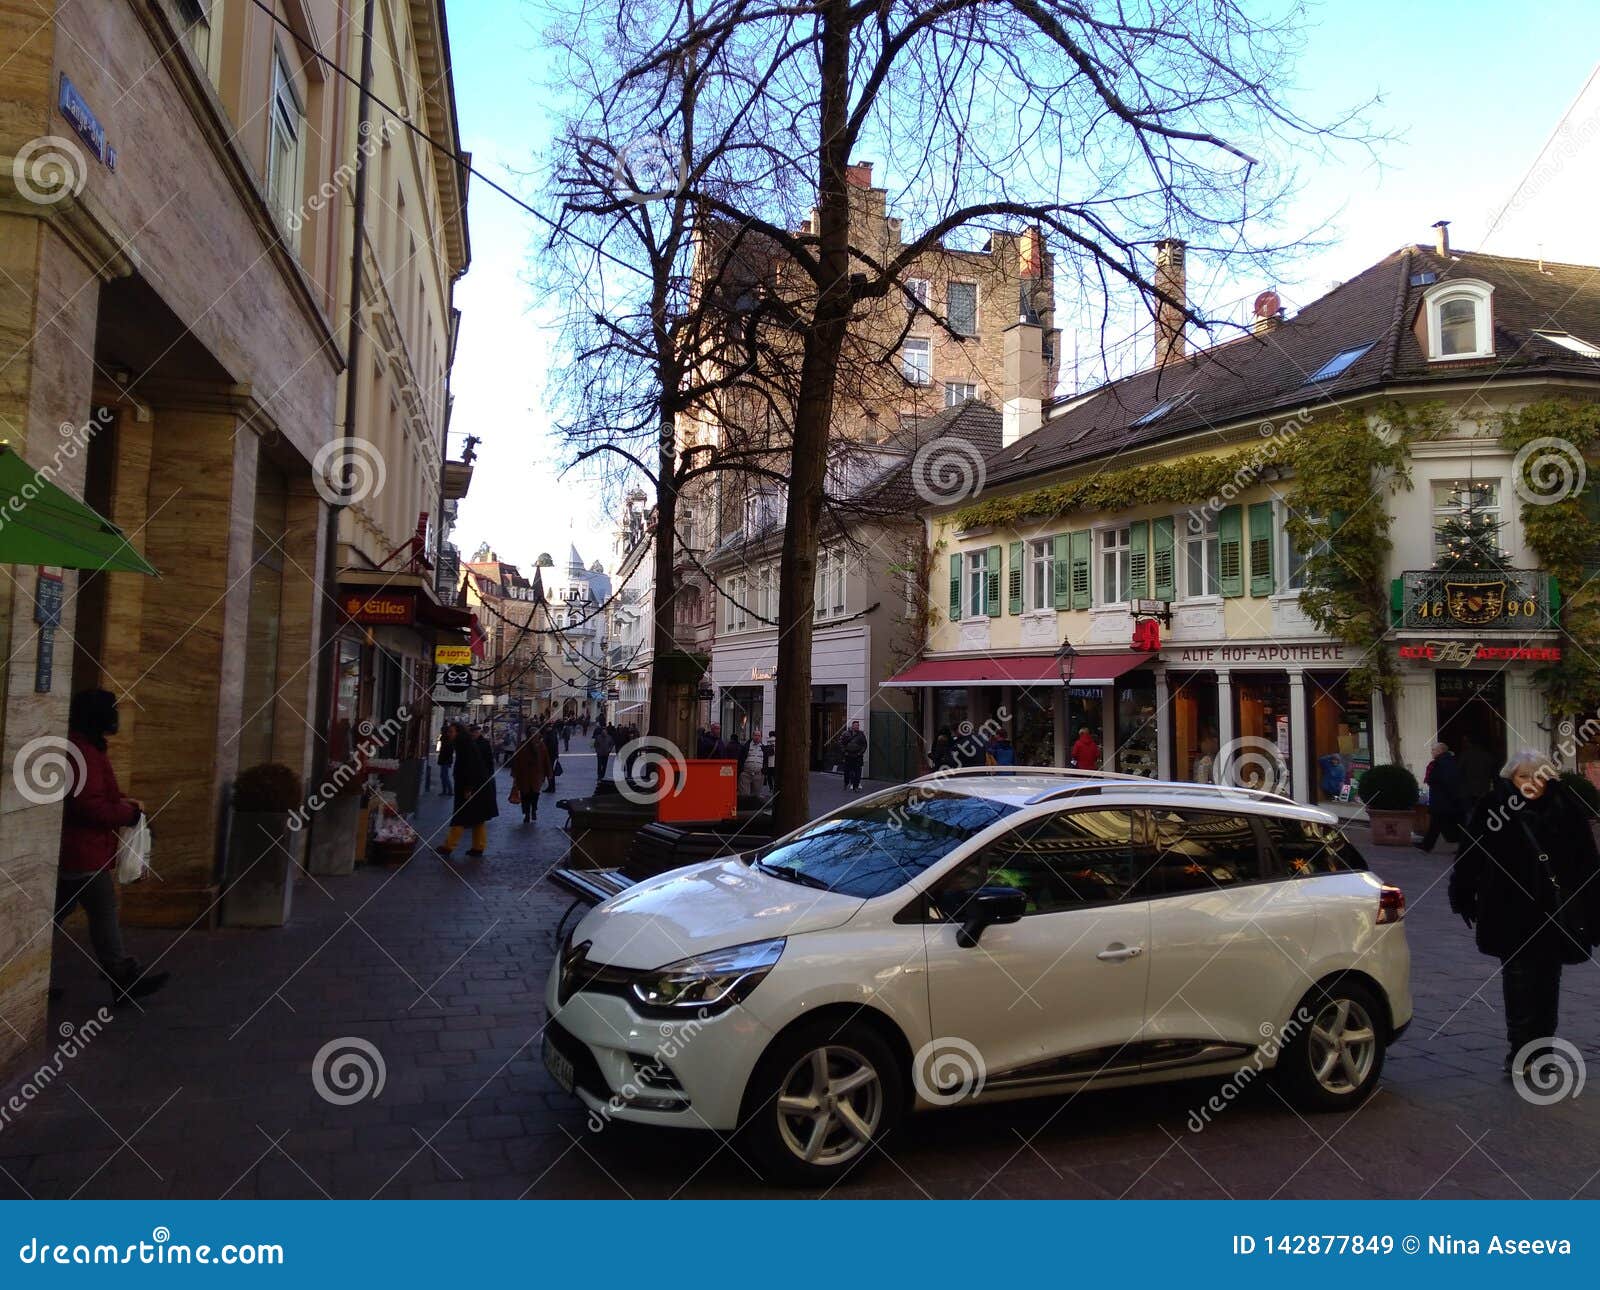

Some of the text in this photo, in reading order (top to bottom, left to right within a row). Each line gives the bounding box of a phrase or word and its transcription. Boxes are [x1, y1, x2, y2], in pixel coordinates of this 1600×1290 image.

[365, 601, 405, 615] Eilles
[447, 650, 470, 658] LOTTO
[1182, 645, 1345, 662] ALTE HOF-APOTHEKE
[1424, 640, 1483, 668] Hof
[1476, 647, 1561, 660] APOTHEKE
